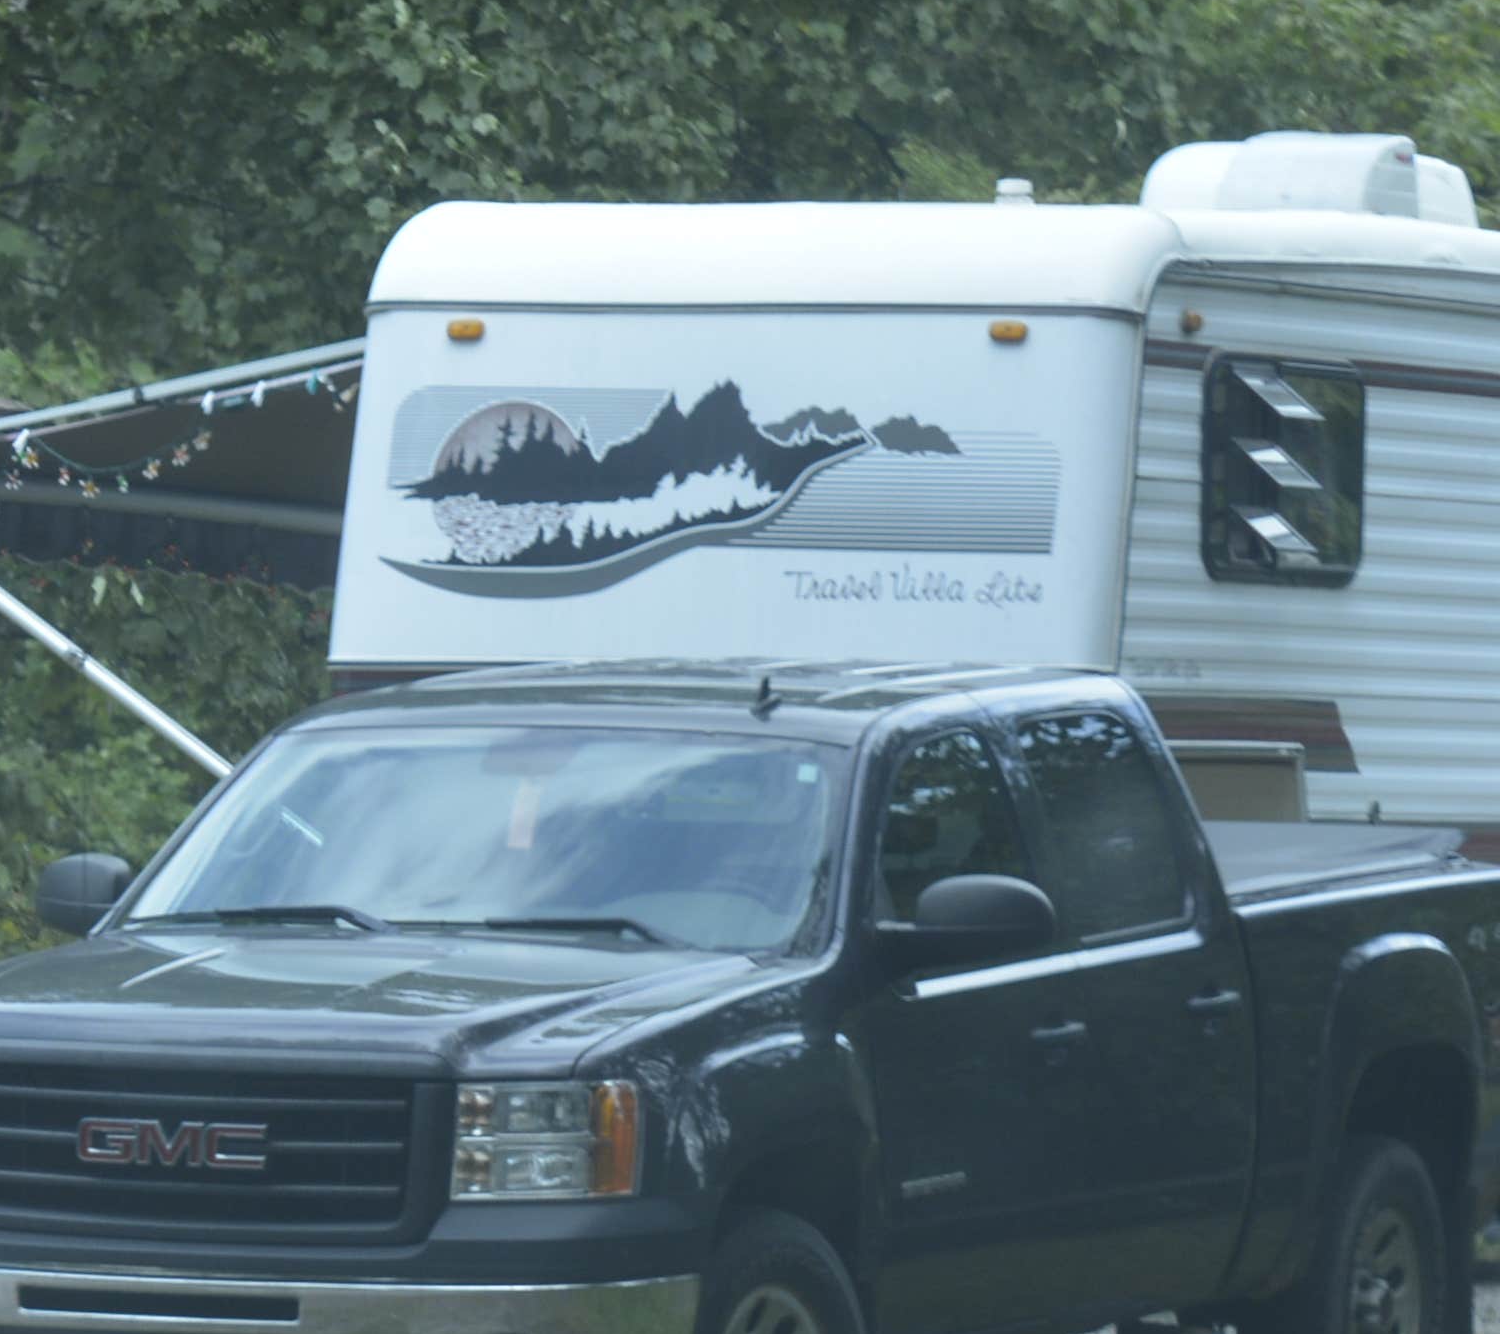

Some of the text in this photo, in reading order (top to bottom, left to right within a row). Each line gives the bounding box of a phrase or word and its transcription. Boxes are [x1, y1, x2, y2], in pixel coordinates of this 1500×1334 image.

[783, 563, 1043, 609] Travel Villa Lite
[77, 1117, 269, 1169] GMC
